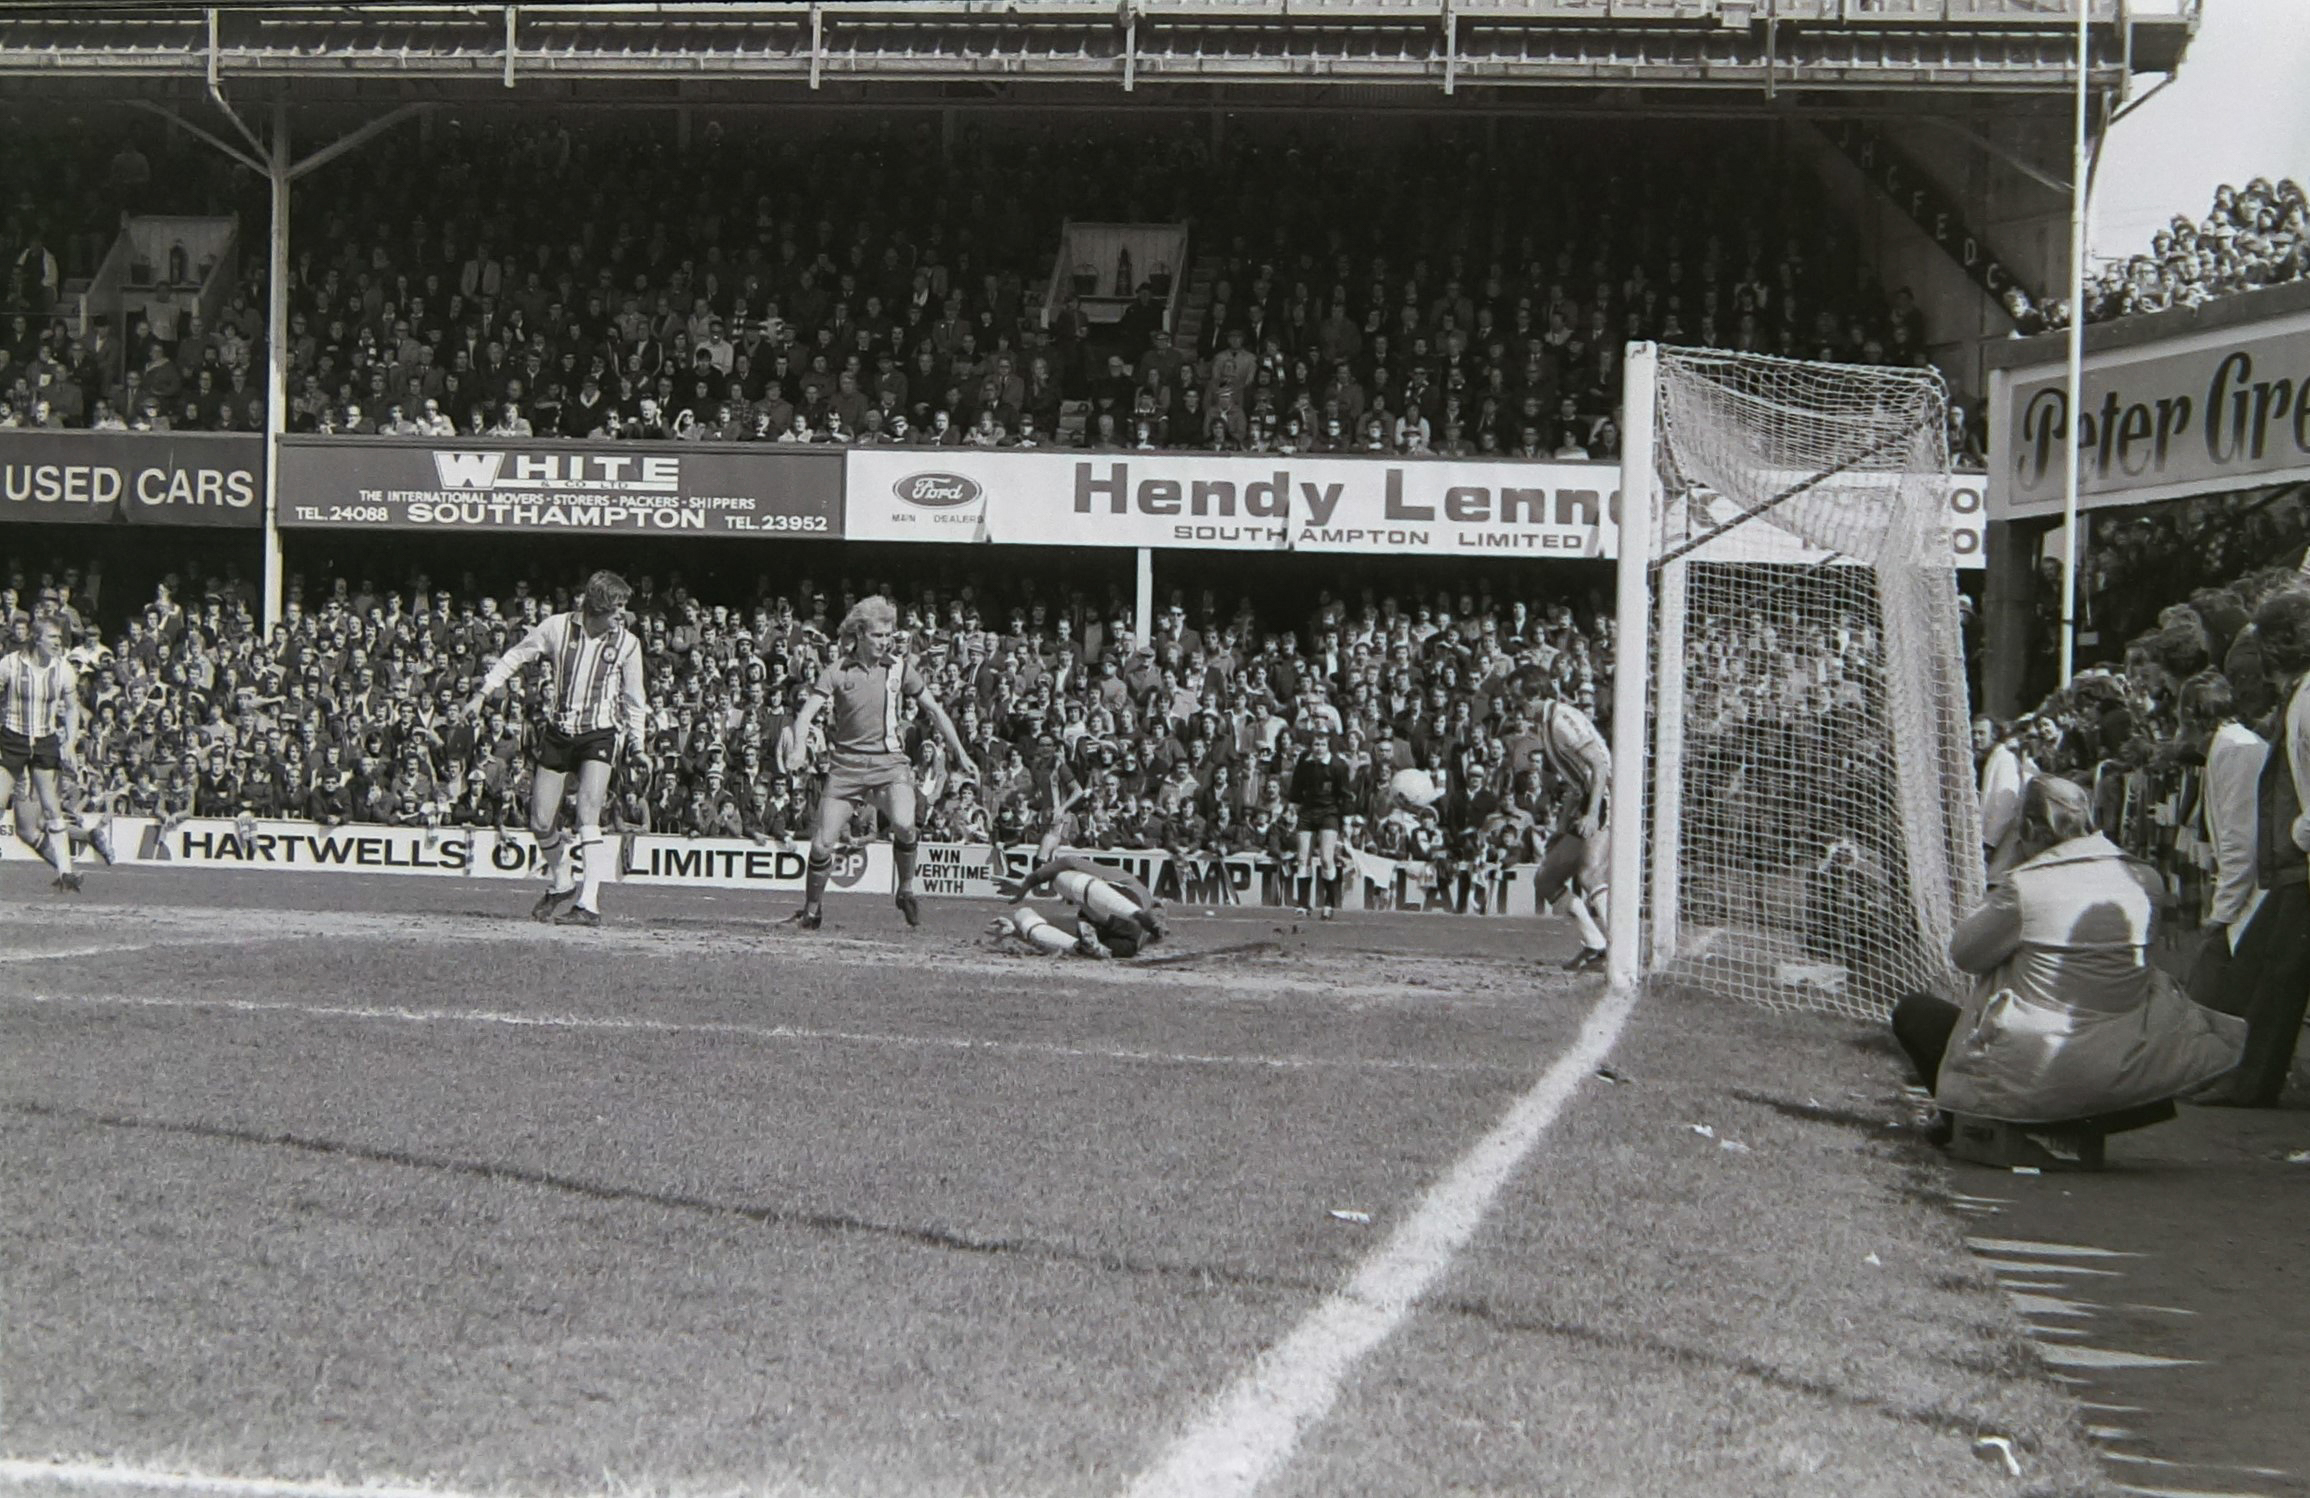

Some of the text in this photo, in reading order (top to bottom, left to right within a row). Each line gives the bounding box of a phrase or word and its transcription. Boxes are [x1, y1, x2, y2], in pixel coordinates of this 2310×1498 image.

[1913, 191, 1926, 218] F
[1936, 213, 1949, 240] E
[1964, 237, 1978, 266] D
[1987, 262, 2000, 290] C
[433, 451, 680, 490] WHITE
[5, 463, 255, 508] USED CARS
[912, 476, 964, 500] Ford
[1074, 462, 1344, 526] Hendy
[359, 490, 382, 502] THE
[387, 490, 487, 505] INTERNATIONAL
[492, 492, 543, 506] MOVERS
[554, 494, 609, 508] STORERS
[620, 496, 678, 509] PACKERS
[689, 497, 756, 511] SHIPPERS
[407, 503, 705, 530] SOUTHAMPTON
[892, 514, 984, 524] MAIN DEALERS
[1458, 530, 1583, 550] LIMITED
[183, 831, 466, 869] HARTWELLS
[929, 848, 960, 864] WIN
[831, 853, 865, 877] BP
[923, 879, 964, 894] WITH
